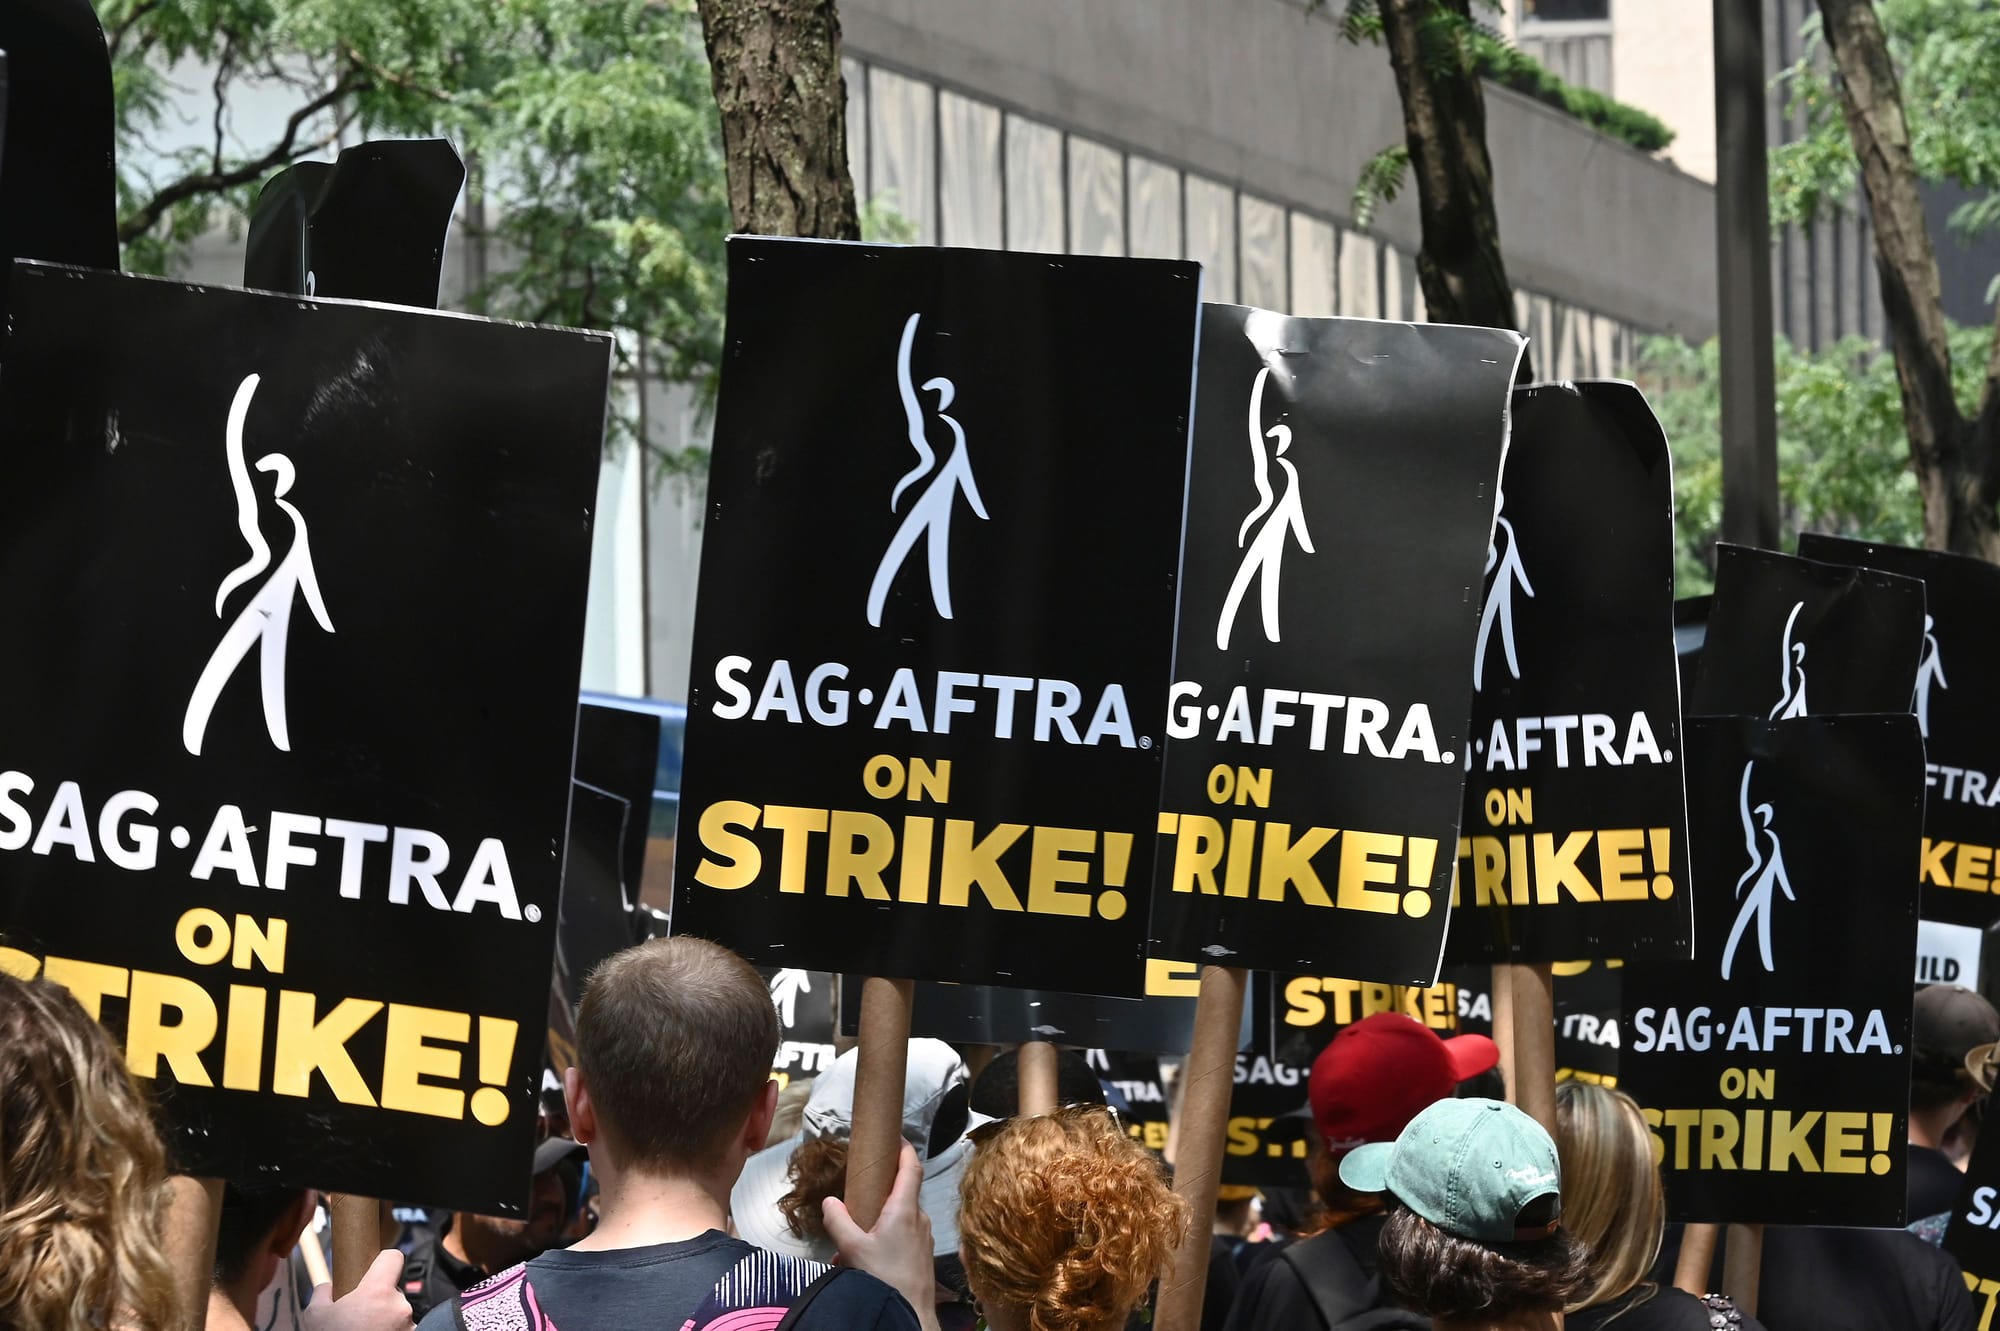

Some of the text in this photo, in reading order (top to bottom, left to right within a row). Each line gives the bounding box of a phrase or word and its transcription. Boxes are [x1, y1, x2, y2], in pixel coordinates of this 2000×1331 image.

[863, 754, 951, 803] ON
[1207, 763, 1273, 808] ON
[1485, 788, 1533, 826] ON
[694, 800, 1134, 921] STRIKE!
[174, 907, 288, 974] ON
[0, 946, 519, 1127] TRIKE!
[1719, 1067, 1776, 1100] ON
